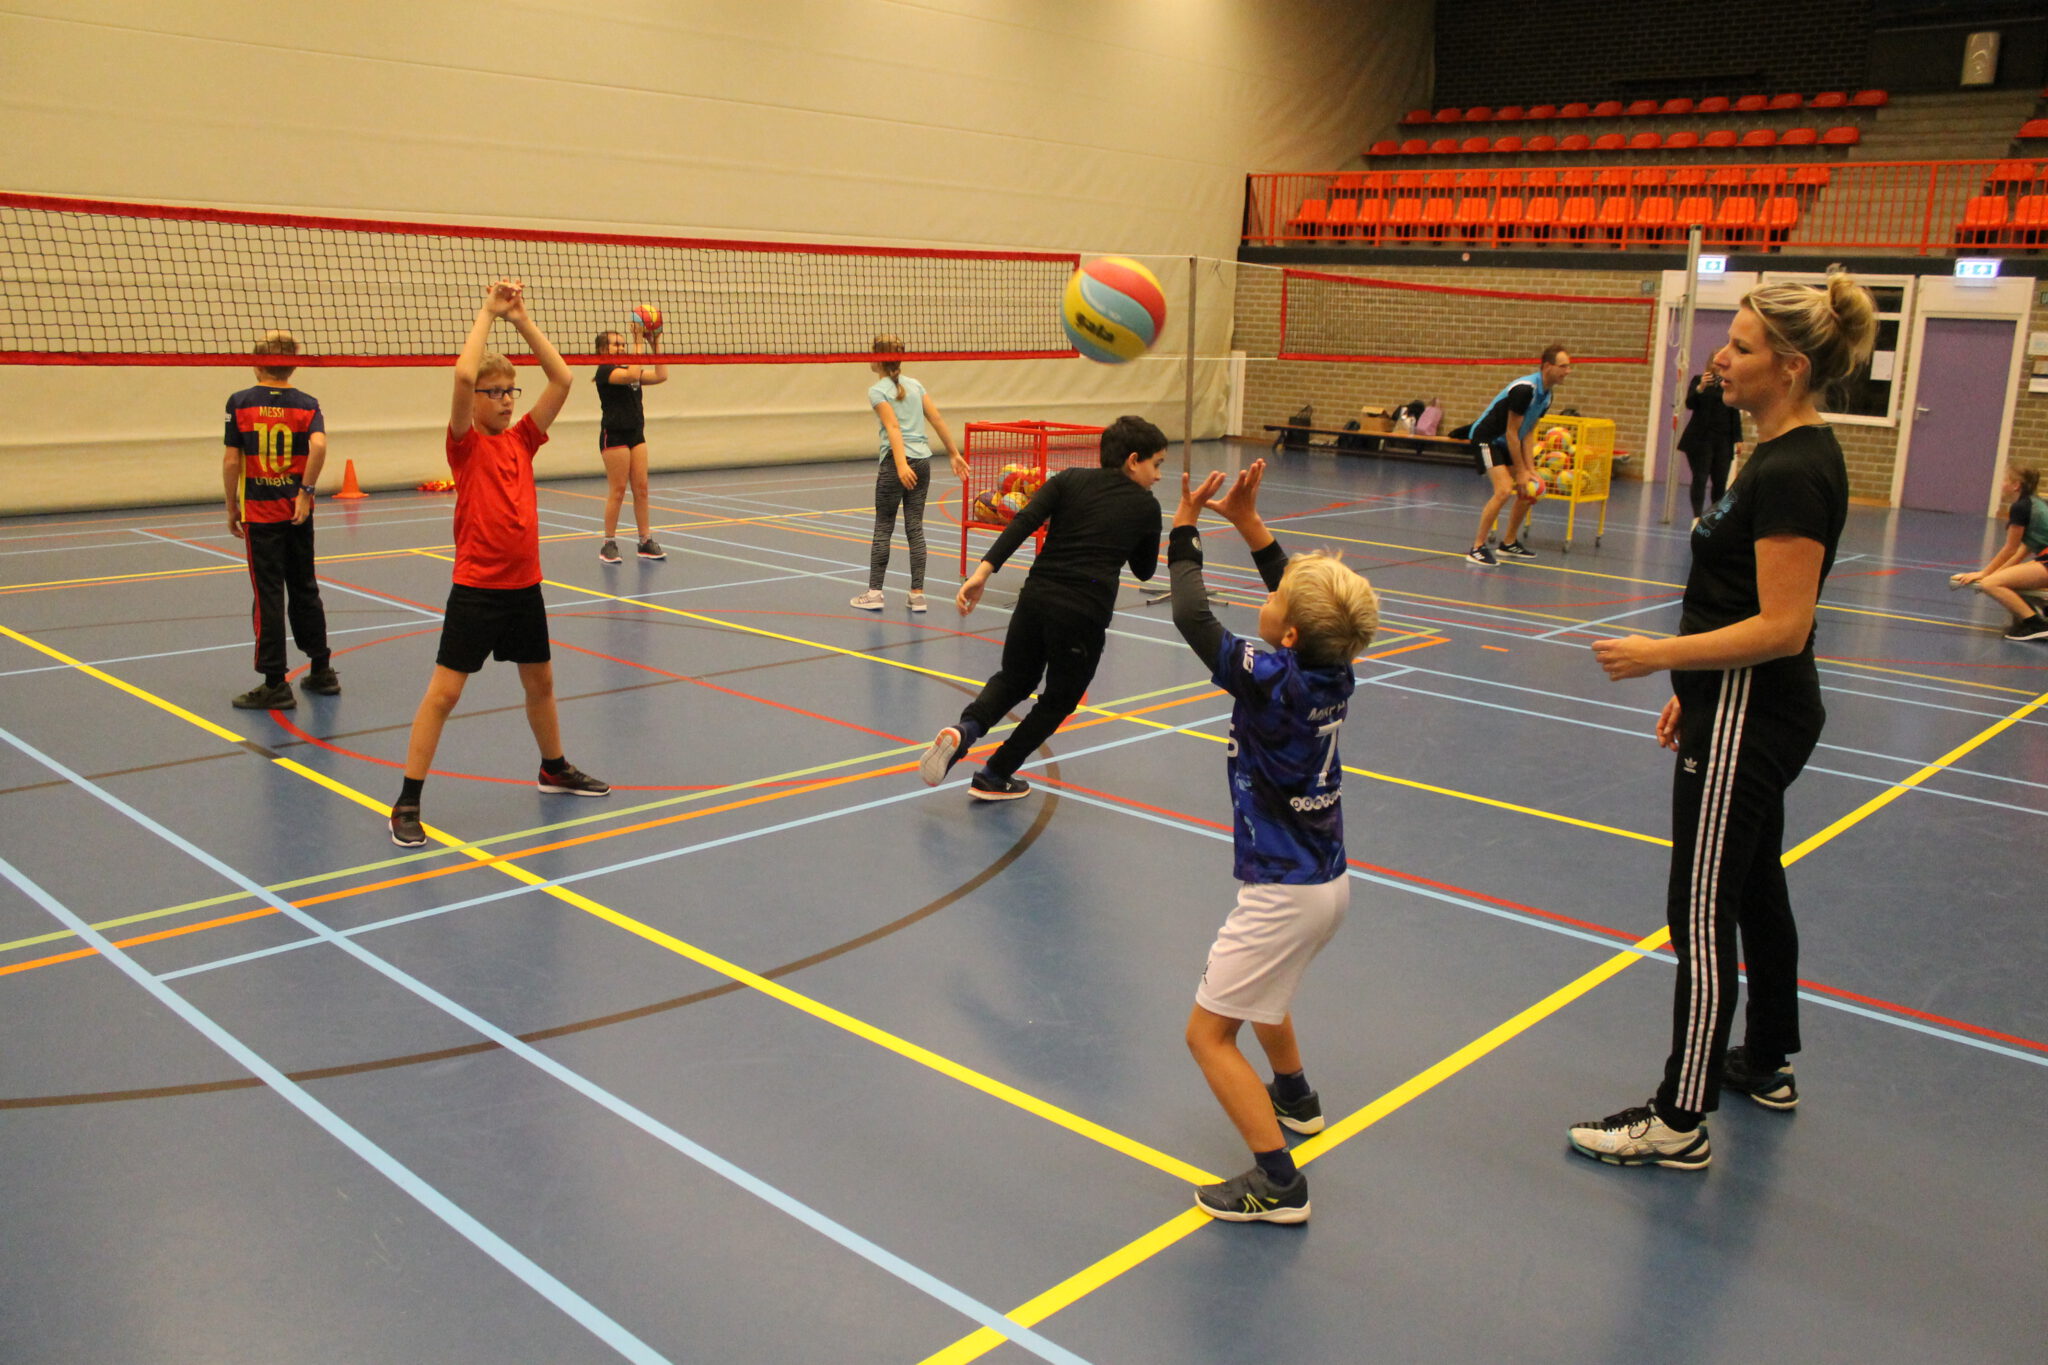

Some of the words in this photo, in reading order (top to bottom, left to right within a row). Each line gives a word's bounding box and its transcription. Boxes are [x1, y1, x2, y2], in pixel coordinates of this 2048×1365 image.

[259, 406, 285, 418] MESSI
[253, 422, 293, 473] 10
[1315, 718, 1343, 788] 7
